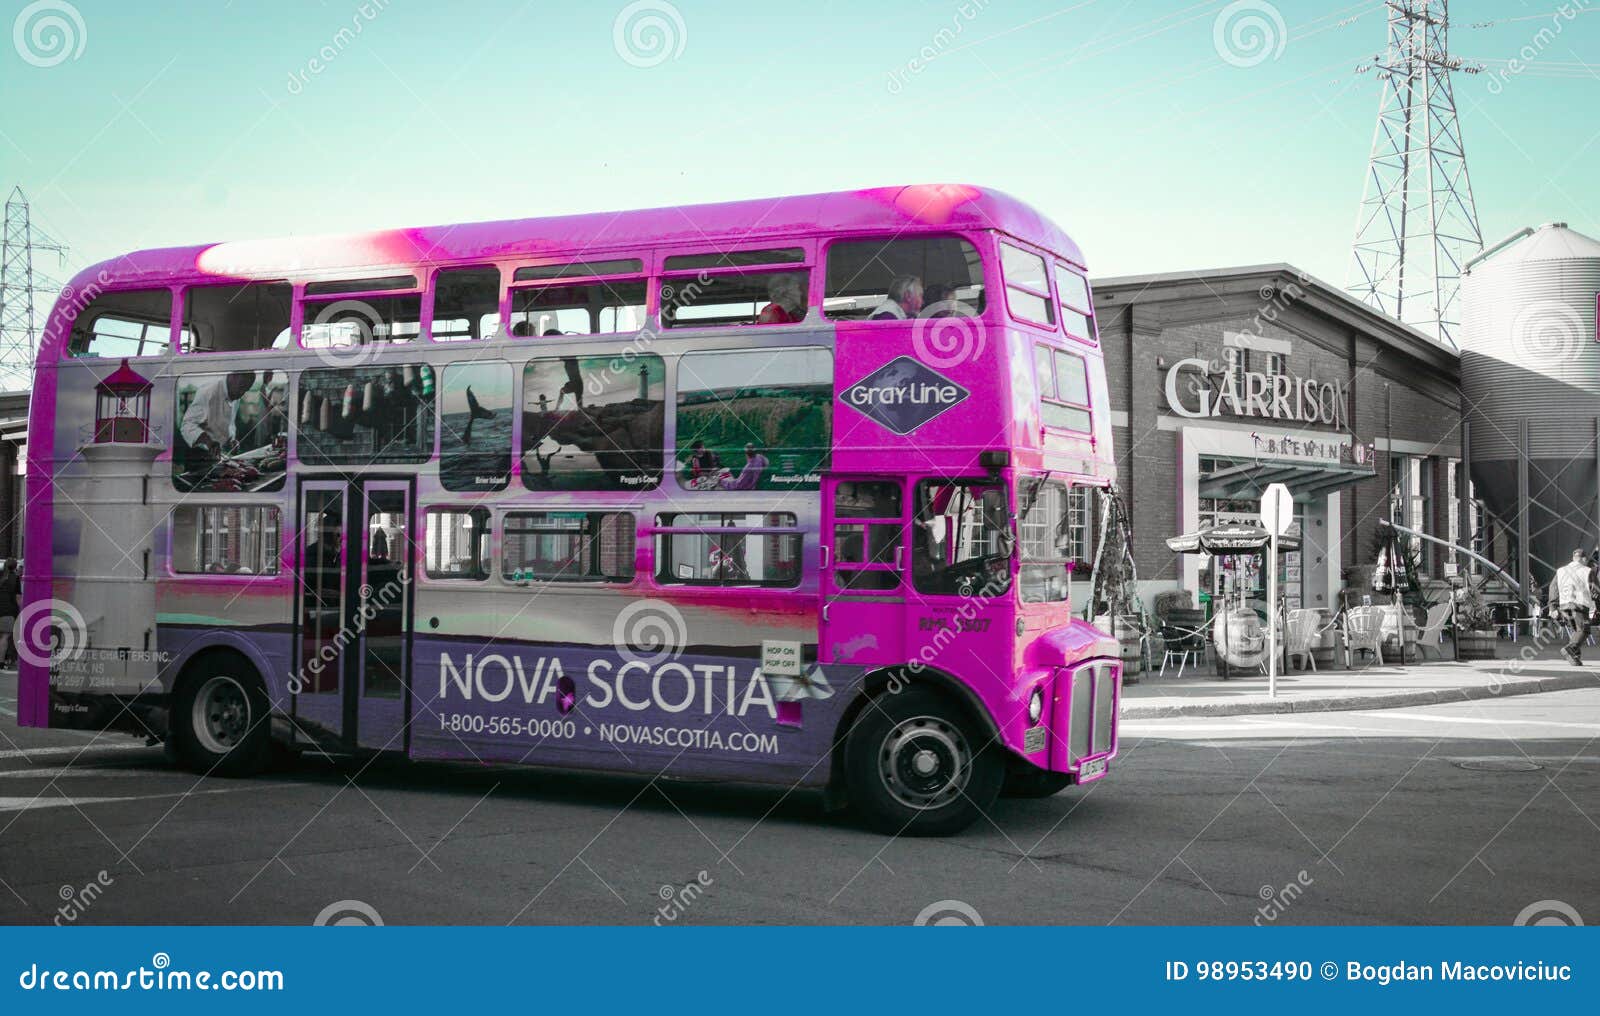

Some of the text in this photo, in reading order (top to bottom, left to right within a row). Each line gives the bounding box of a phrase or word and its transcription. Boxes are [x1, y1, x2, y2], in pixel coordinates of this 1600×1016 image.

[1268, 443, 1339, 461] BREWIN
[767, 647, 782, 655] HOP
[439, 652, 777, 719] NOVA SCOTIA
[439, 713, 779, 755] 1-800-565-0000 NOVASCOTIA.COM
